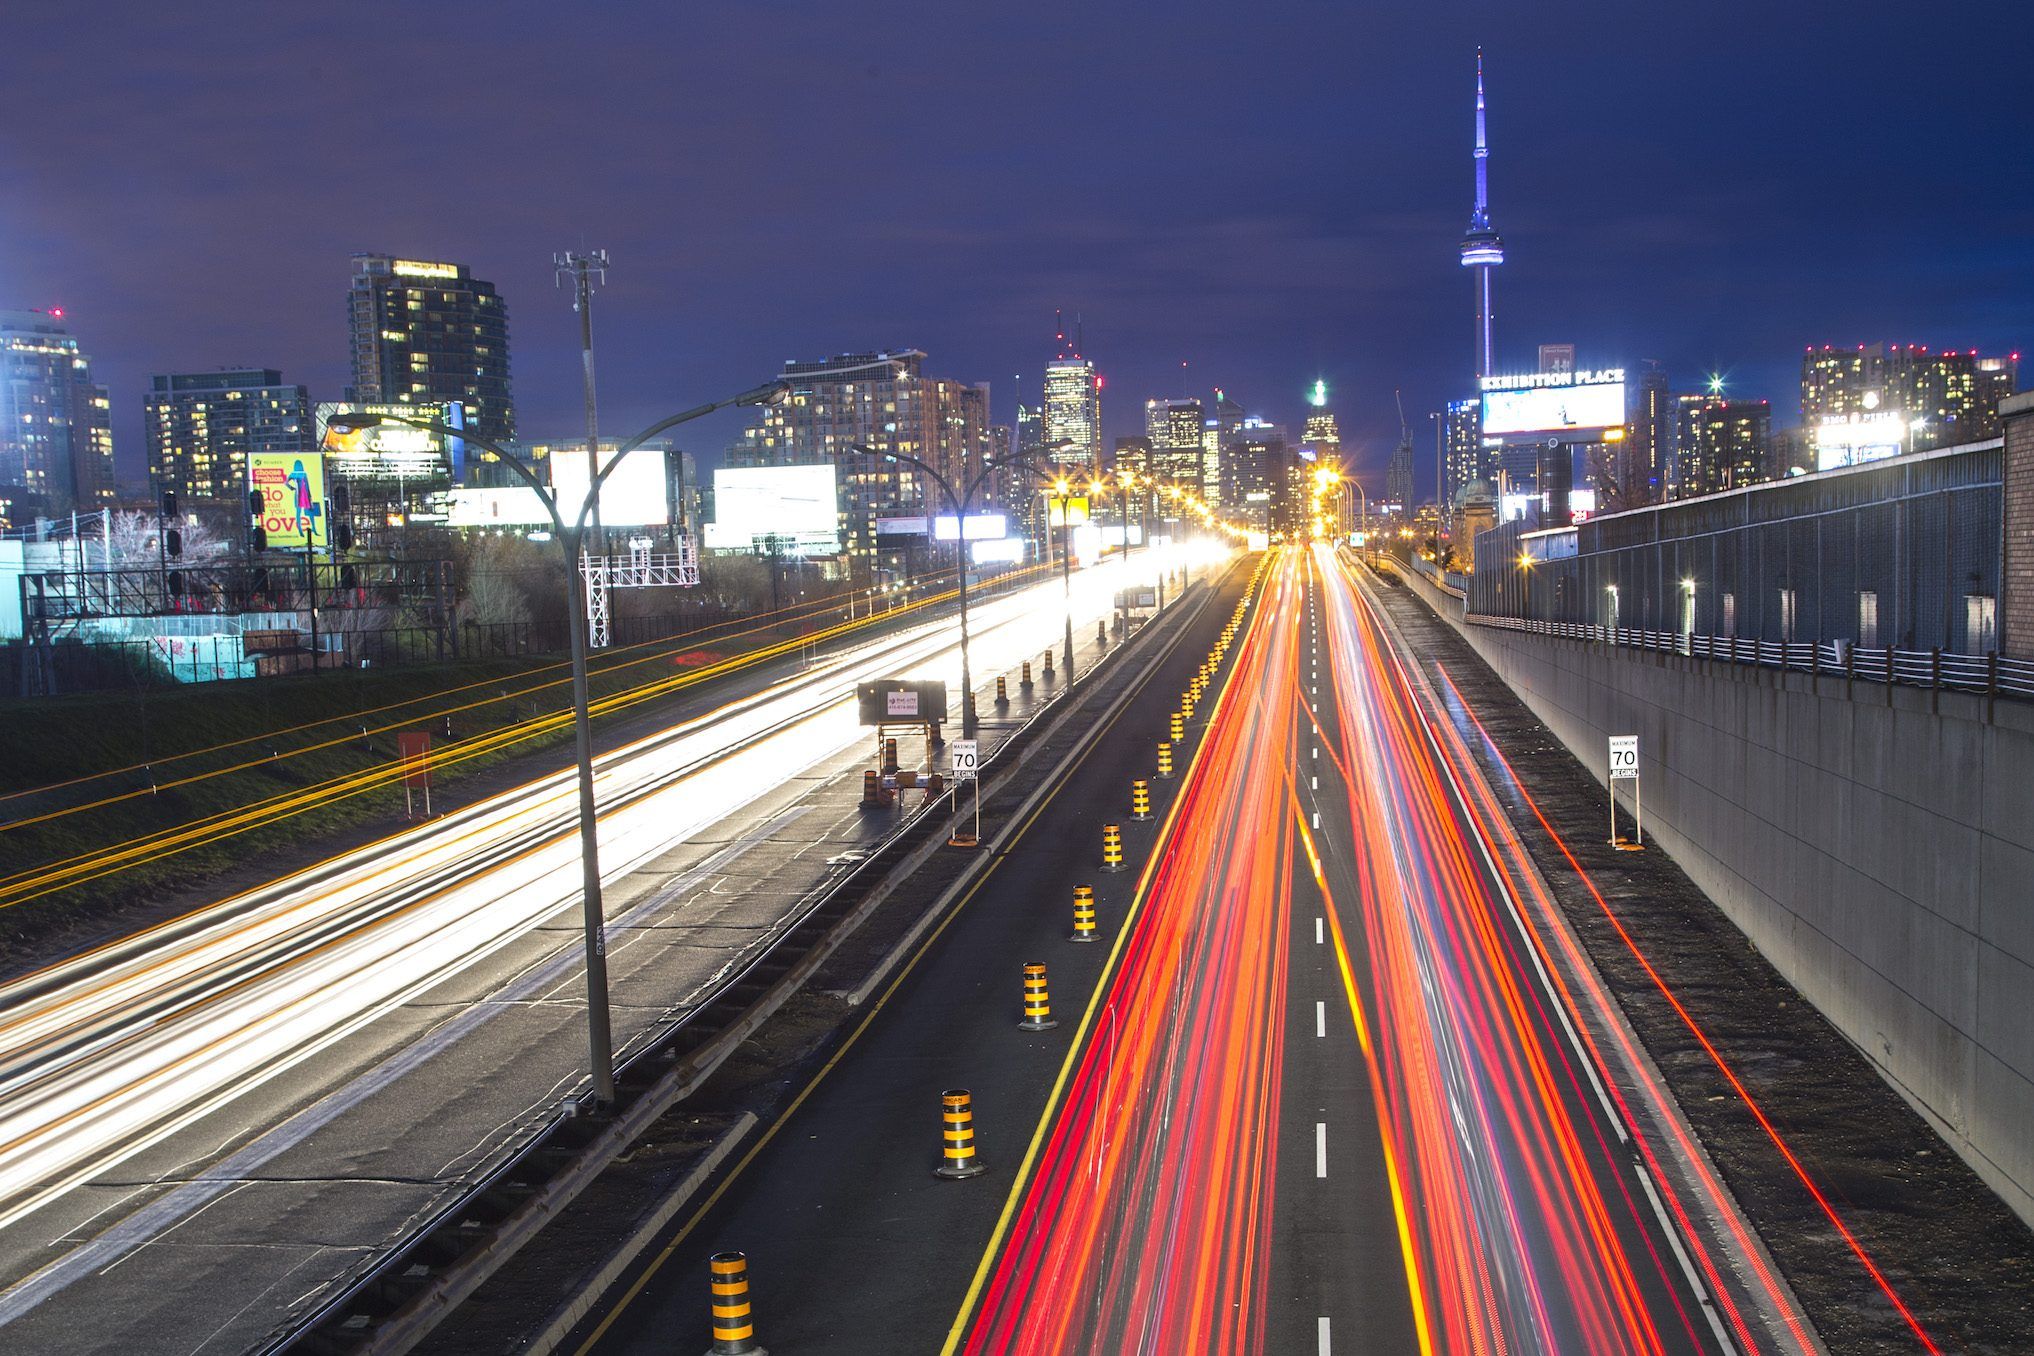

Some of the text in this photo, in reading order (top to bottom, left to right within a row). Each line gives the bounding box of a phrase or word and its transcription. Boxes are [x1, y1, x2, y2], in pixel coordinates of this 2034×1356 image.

[1481, 369, 1625, 390] EXHIBITION PLACE
[1822, 415, 1847, 425] BMO
[261, 487, 283, 501] do
[259, 514, 310, 532] love
[954, 753, 975, 768] 70
[1612, 751, 1635, 766] 70
